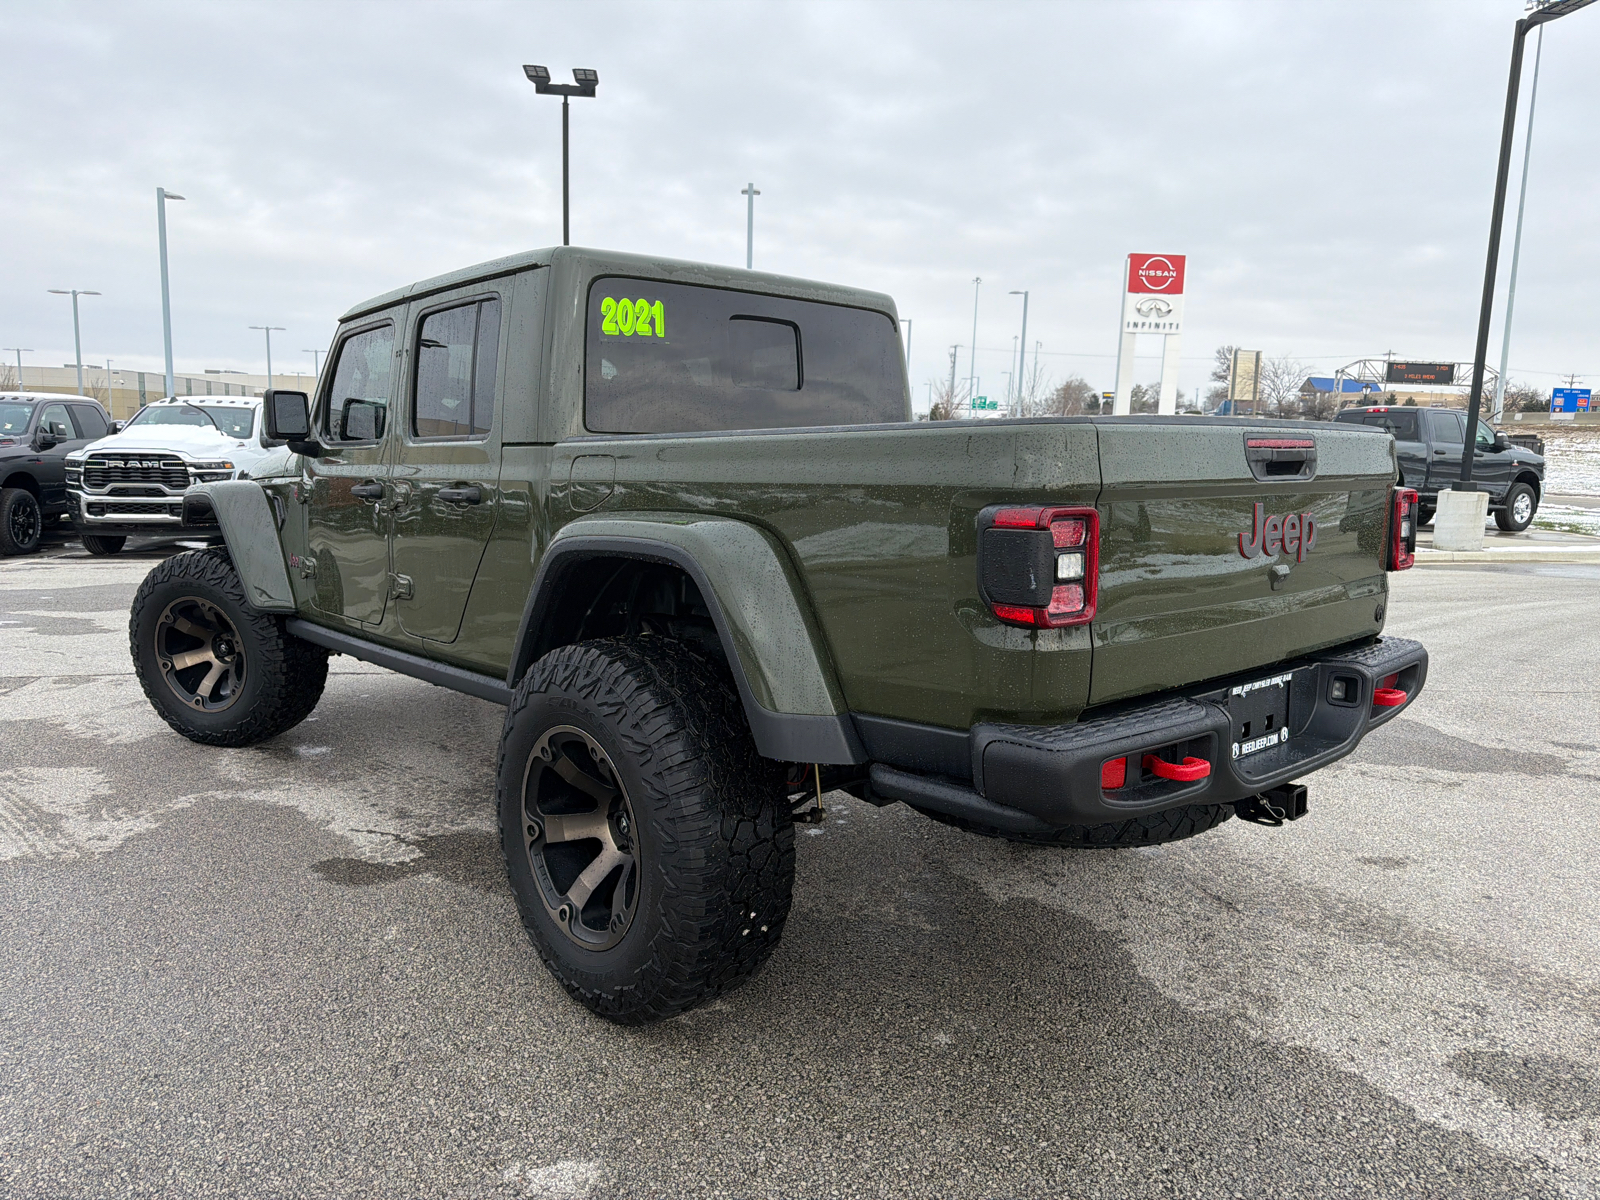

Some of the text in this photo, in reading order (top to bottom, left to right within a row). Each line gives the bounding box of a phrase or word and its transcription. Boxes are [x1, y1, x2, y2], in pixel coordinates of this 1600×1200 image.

[1138, 269, 1176, 277] NISSAN
[601, 297, 665, 338] 2021
[1127, 321, 1179, 330] INFINITI
[108, 460, 159, 468] RAM
[1240, 503, 1317, 563] Jeep
[1242, 733, 1278, 754] REEDJEEP.COM
